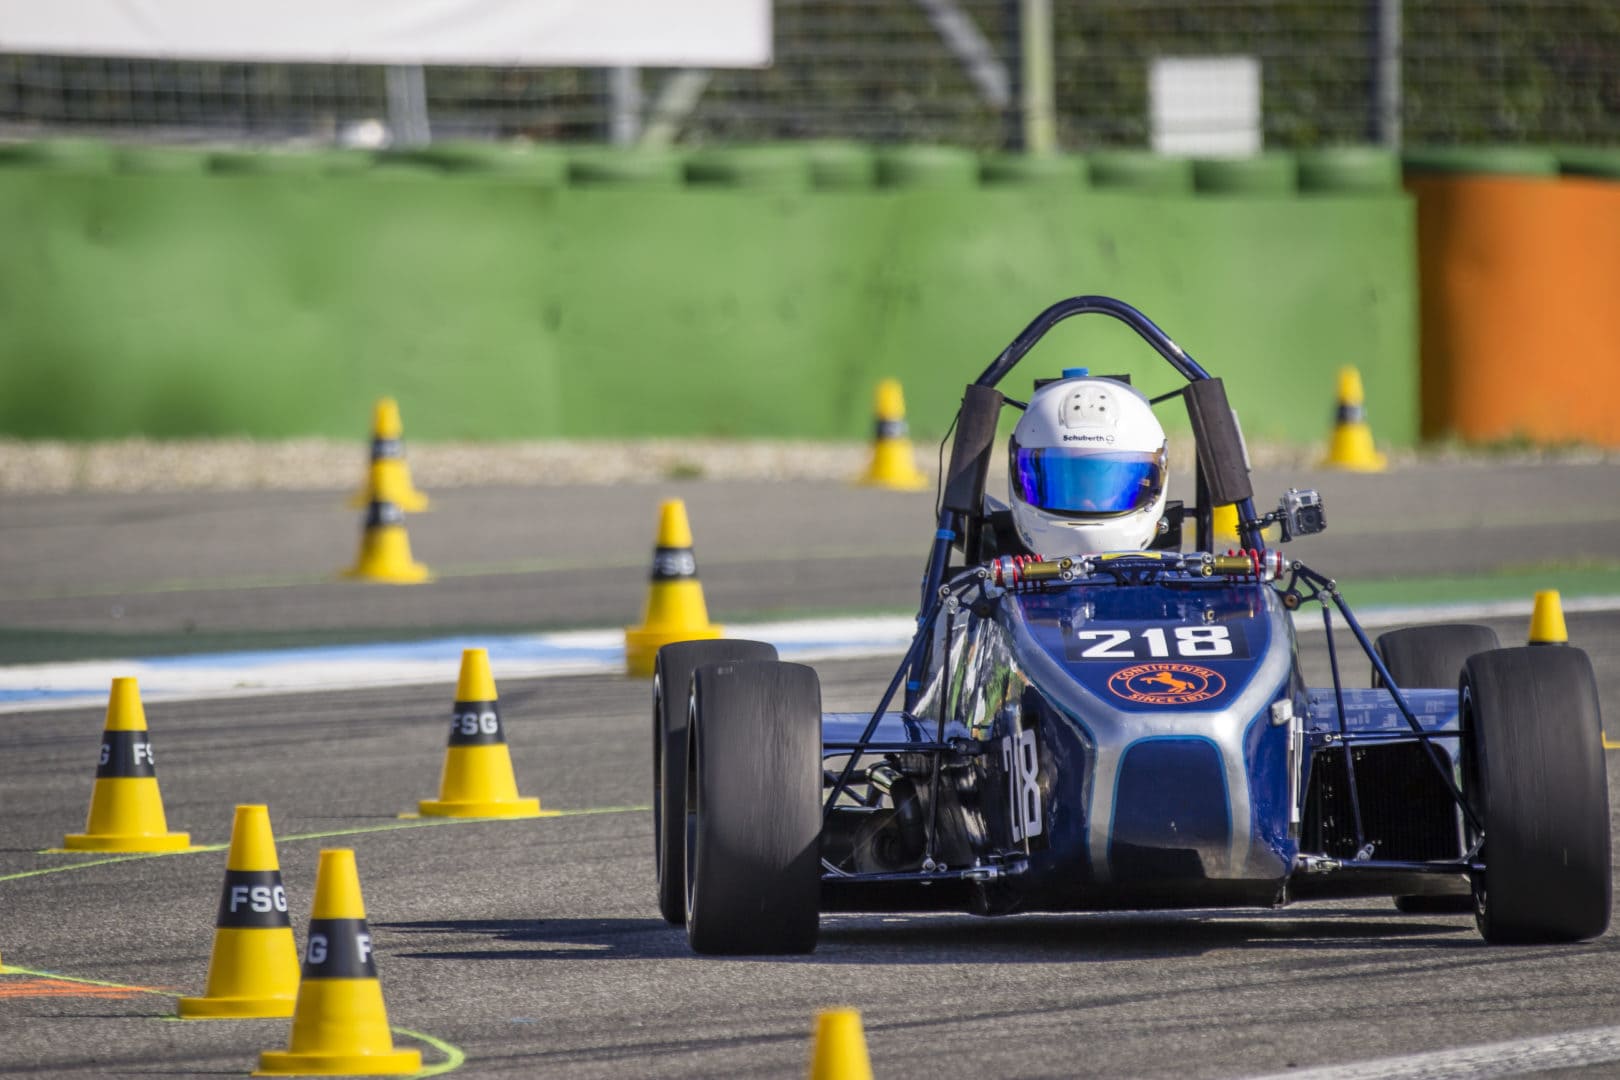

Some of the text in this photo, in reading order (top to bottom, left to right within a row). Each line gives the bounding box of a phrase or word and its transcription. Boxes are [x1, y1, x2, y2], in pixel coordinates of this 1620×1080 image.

[1063, 434, 1104, 442] Schuberth
[1078, 626, 1233, 657] 218
[1116, 664, 1215, 680] CONTINENTAL
[1128, 692, 1176, 703] SINCE
[451, 711, 498, 735] FSG
[230, 885, 288, 913] FSG
